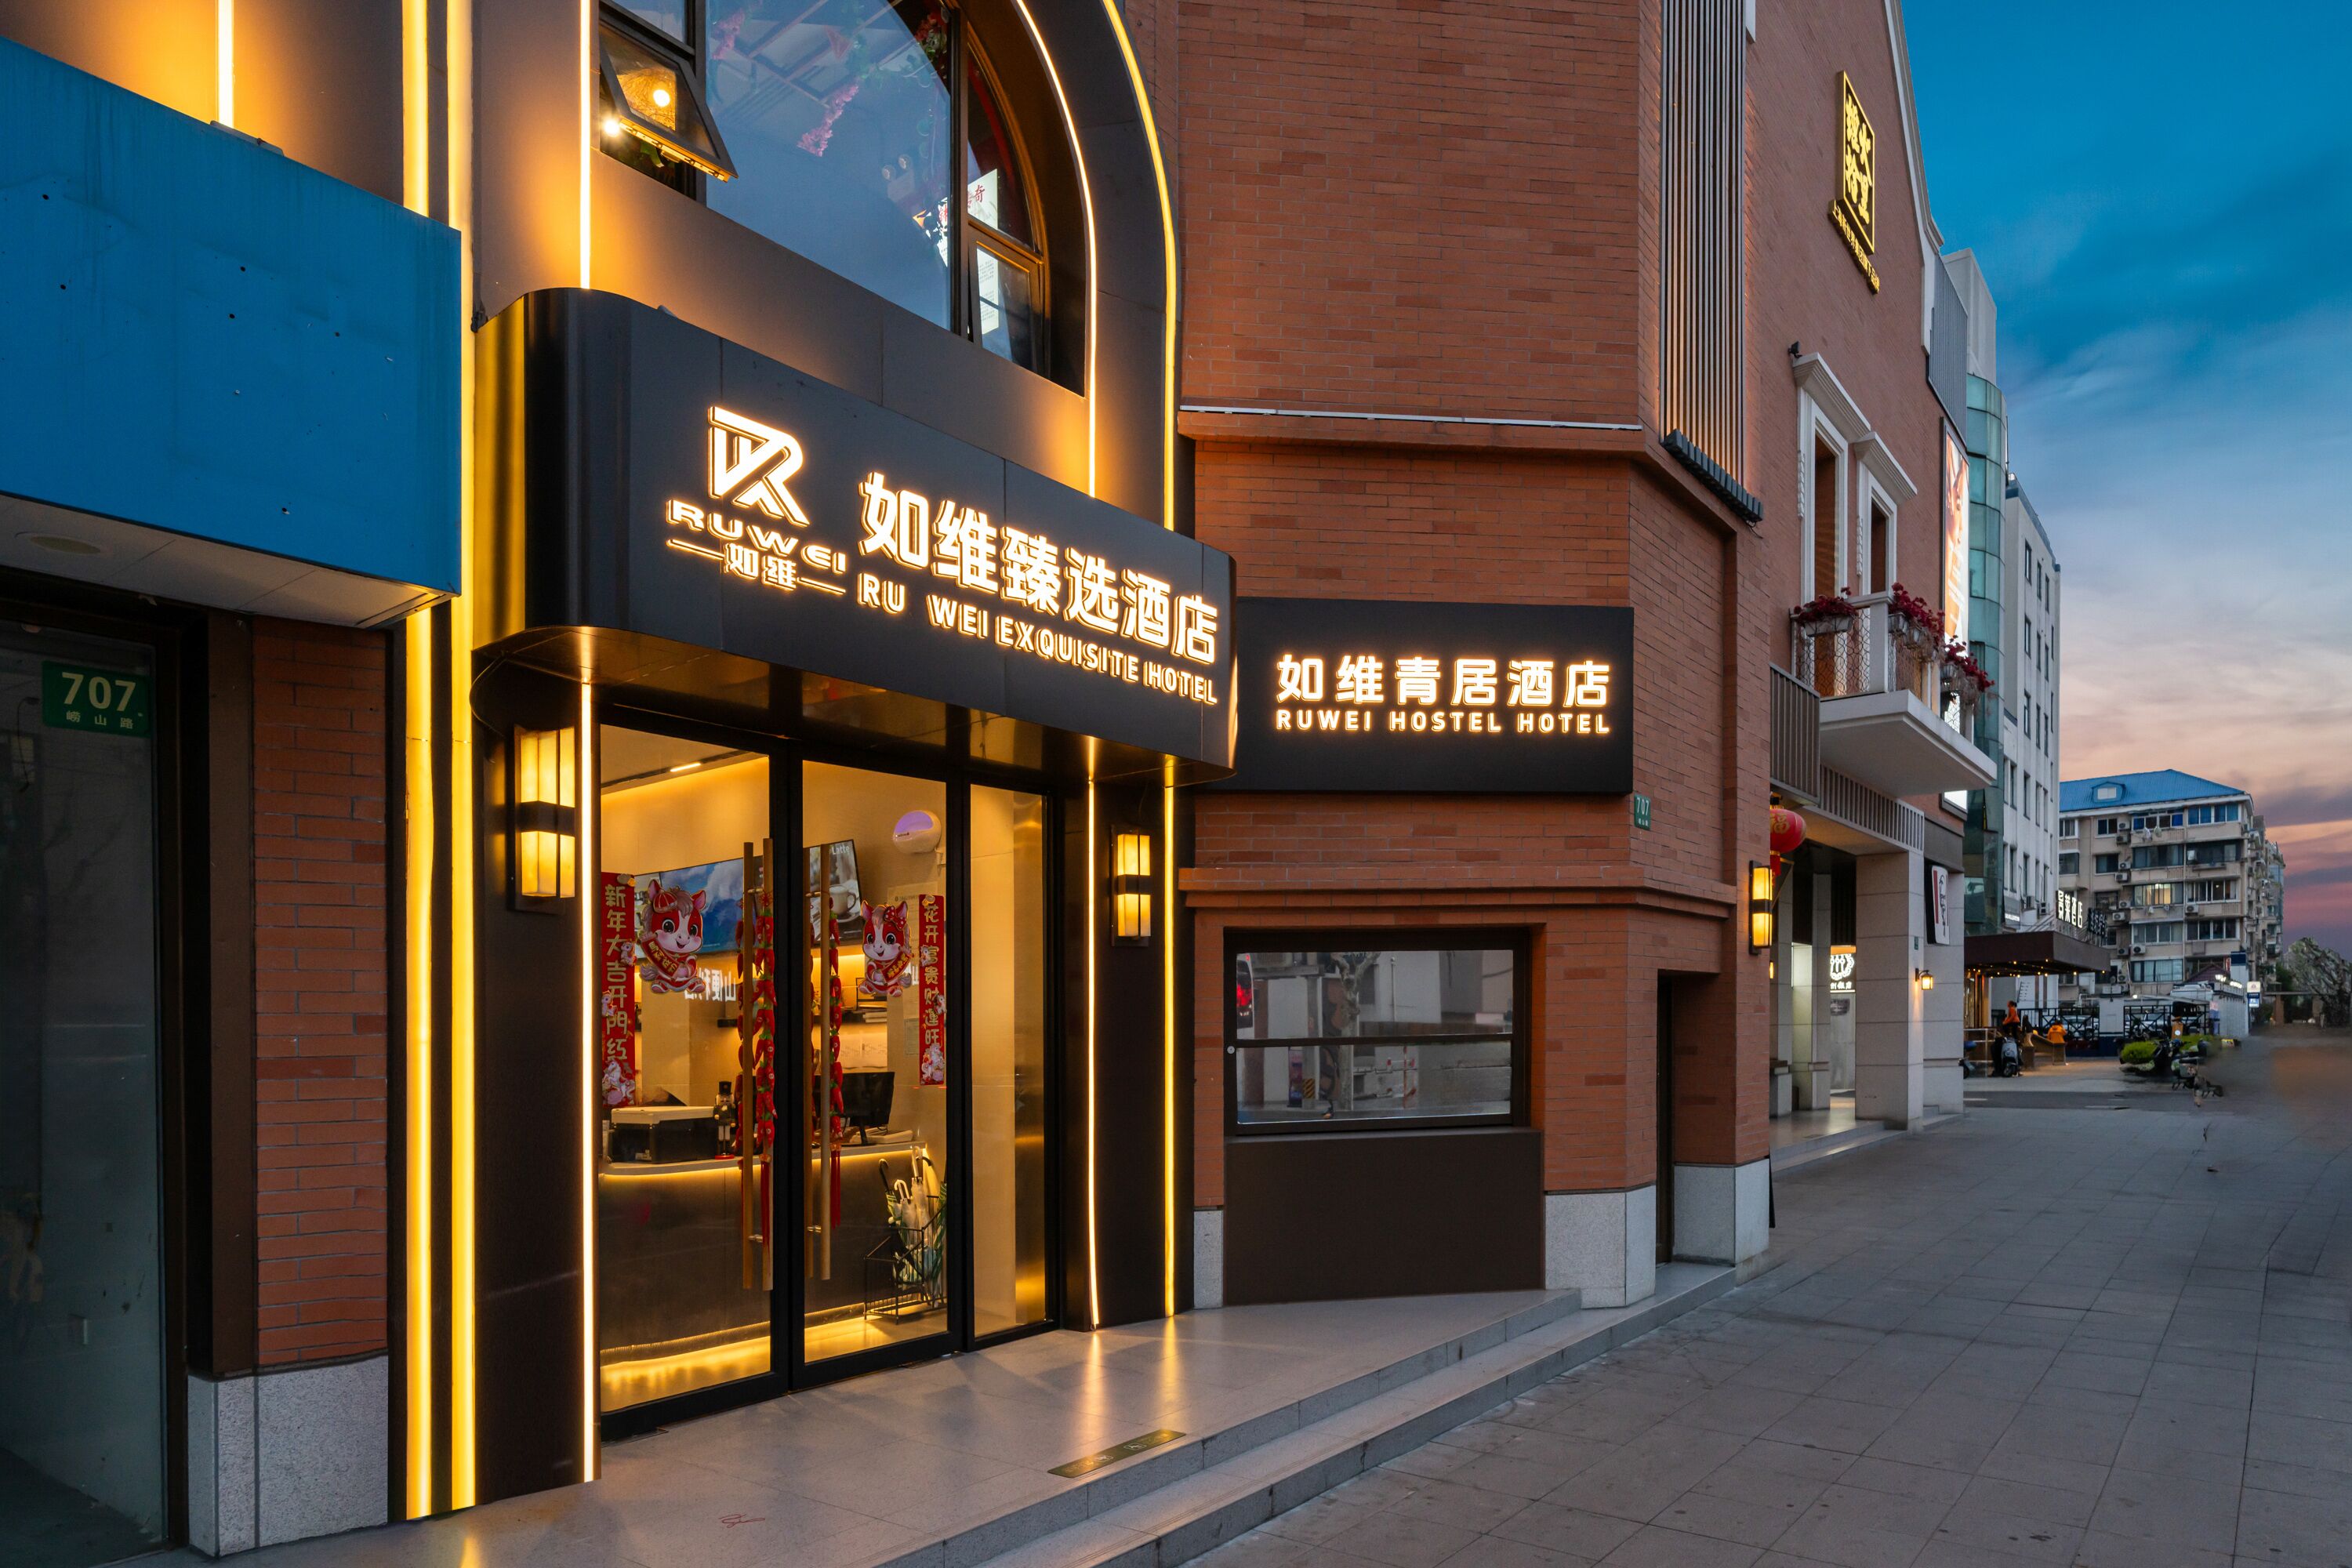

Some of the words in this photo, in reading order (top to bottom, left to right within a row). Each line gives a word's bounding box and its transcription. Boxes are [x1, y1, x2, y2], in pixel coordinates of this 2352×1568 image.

[666, 499, 846, 574] RUWEI
[724, 543, 797, 591] 如维
[858, 472, 1218, 664] 如维臻选酒店
[858, 573, 906, 614] RU
[926, 594, 988, 638] WEI
[995, 615, 1139, 683] EXQUISITE
[1143, 661, 1218, 705] HOTEL
[62, 672, 136, 711] 707
[1277, 654, 1610, 707] 如维青居酒店
[1276, 710, 1371, 731] RUWEI
[1389, 710, 1501, 732] HOSTEL
[1518, 712, 1610, 734] HOTEL
[1636, 797, 1650, 815] 707
